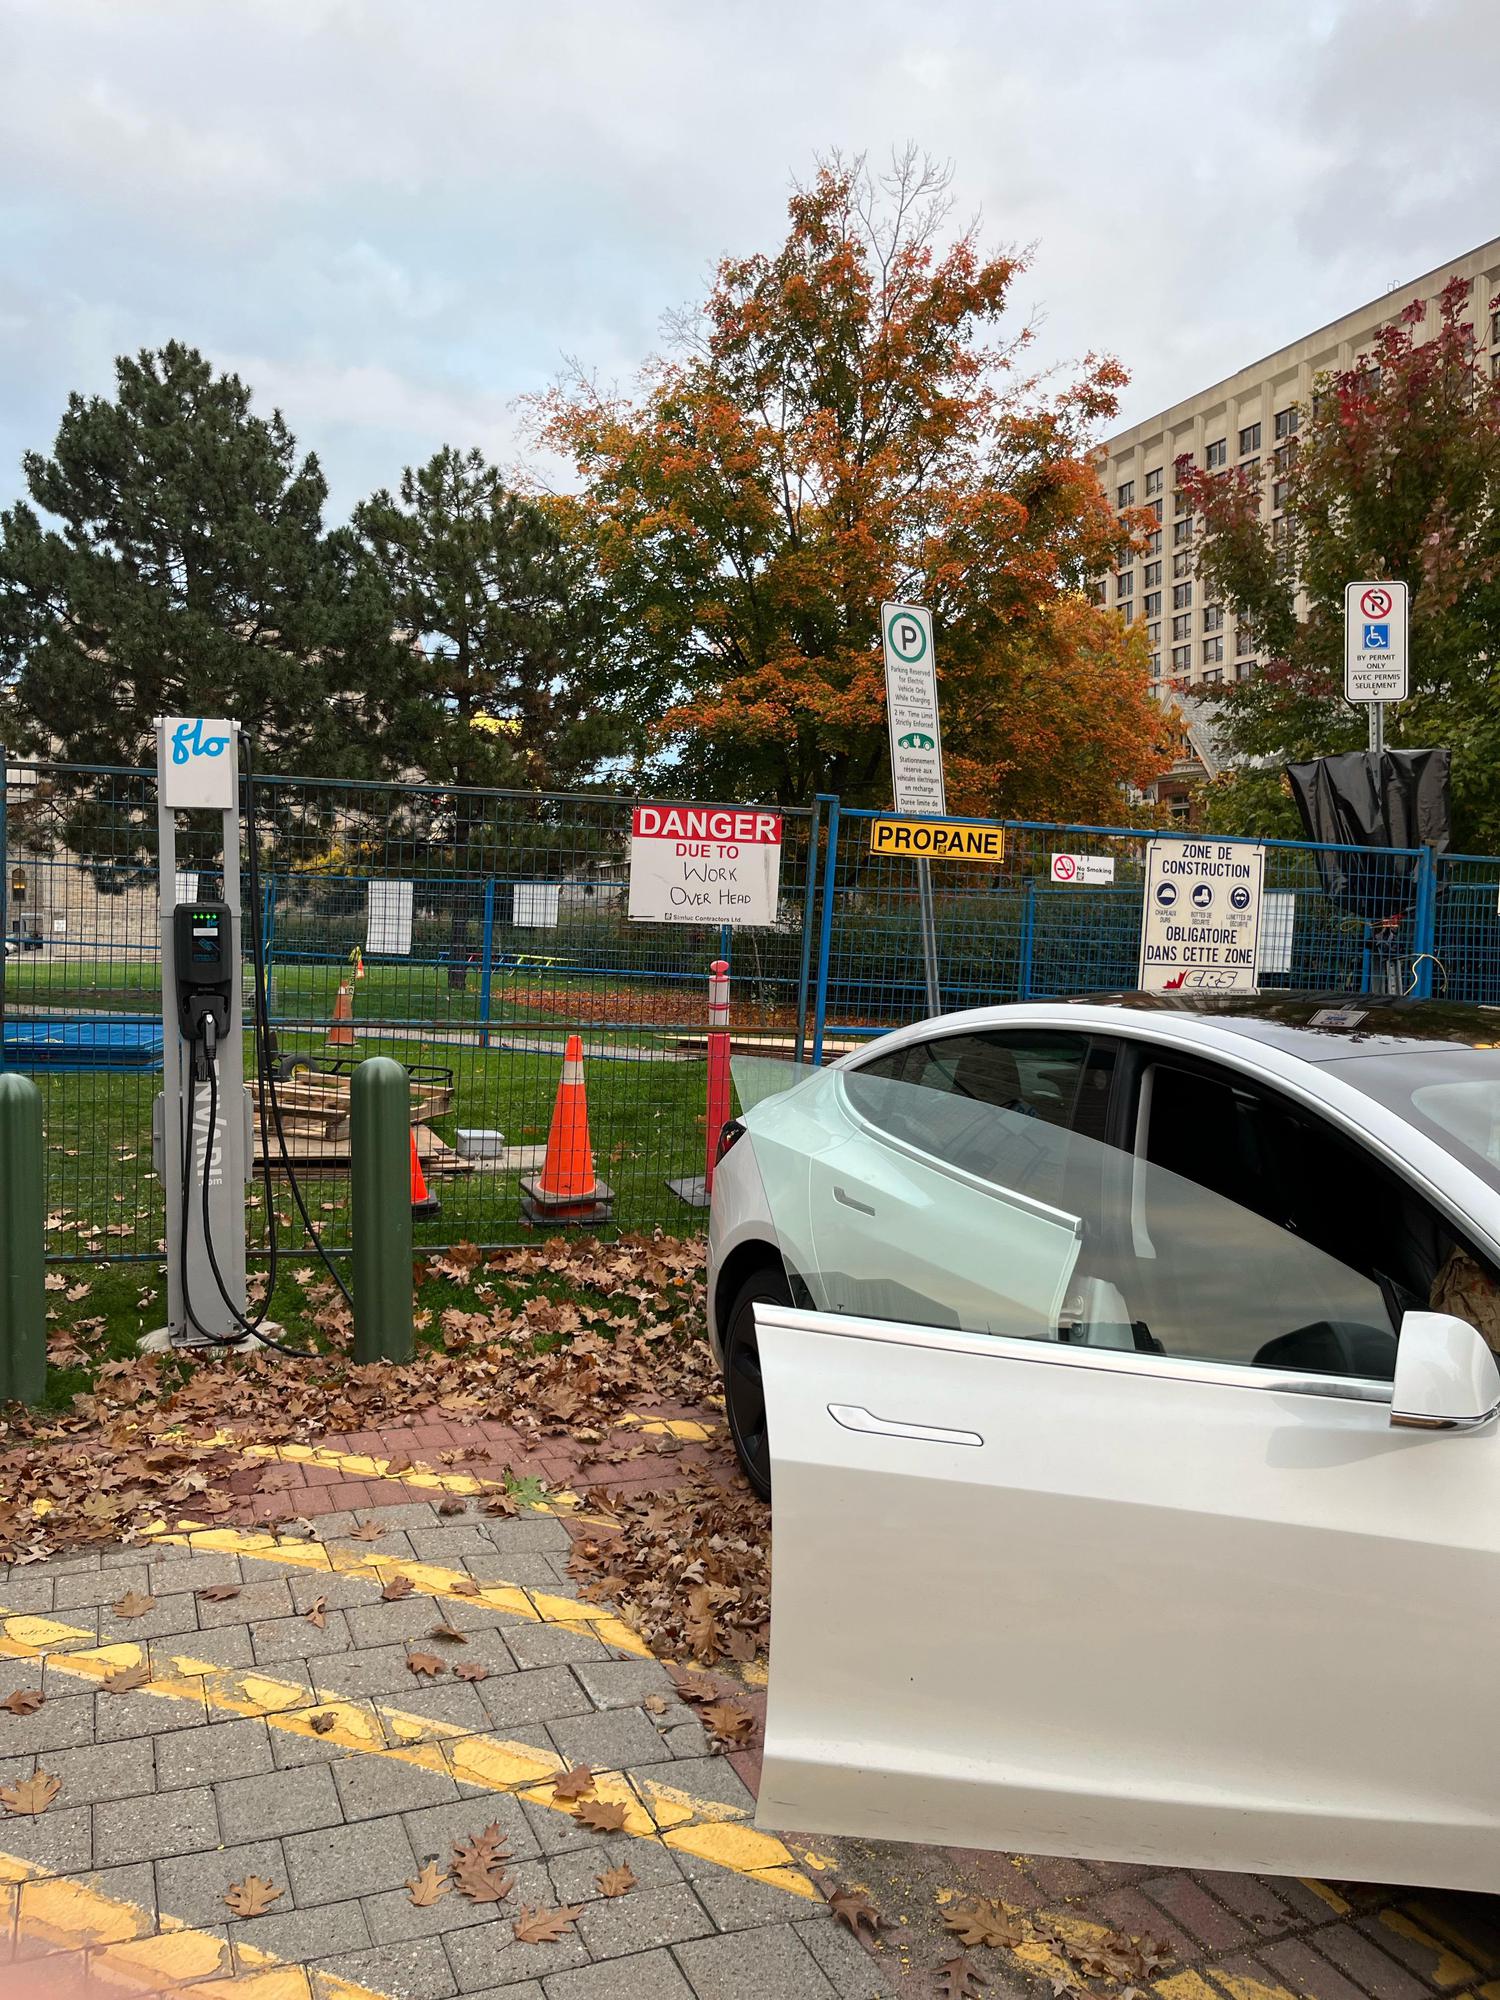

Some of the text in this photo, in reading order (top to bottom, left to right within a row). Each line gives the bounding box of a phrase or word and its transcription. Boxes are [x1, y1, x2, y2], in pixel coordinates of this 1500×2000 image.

[901, 625, 917, 651] P
[890, 665, 931, 677] Parking Reserved
[1374, 673, 1401, 681] PERMIS
[898, 675, 925, 686] for Electric
[1355, 682, 1398, 690] SEULEMENT
[898, 685, 927, 696] Vehicle Only
[895, 693, 931, 706] While Charging
[908, 710, 920, 719] Time
[921, 711, 934, 720] Limit
[895, 718, 934, 729] Strictly Enforced
[171, 716, 231, 765] flo
[899, 755, 935, 766] Stationnement
[912, 785, 935, 795] recharge
[916, 798, 931, 807] limite
[931, 799, 939, 808] de
[639, 808, 777, 842] DANGER
[878, 825, 999, 855] PROPANE
[675, 843, 739, 860] DUE TO
[1182, 844, 1233, 861] ZONE DE
[683, 861, 737, 883] WORK
[1086, 866, 1112, 875] Smoking
[1162, 860, 1251, 879] CONSTRUCTION
[669, 886, 752, 906] OVER HEAD
[694, 915, 730, 923] Contractors
[1155, 909, 1177, 917] CHAPEAUX
[1190, 911, 1212, 920] BOTTES DE
[1166, 925, 1238, 945] OBLIGATOIRE
[1146, 945, 1253, 964] DANS CETTE ZONE
[1184, 969, 1239, 989] CRS
[192, 1058, 228, 1177] NVARI
